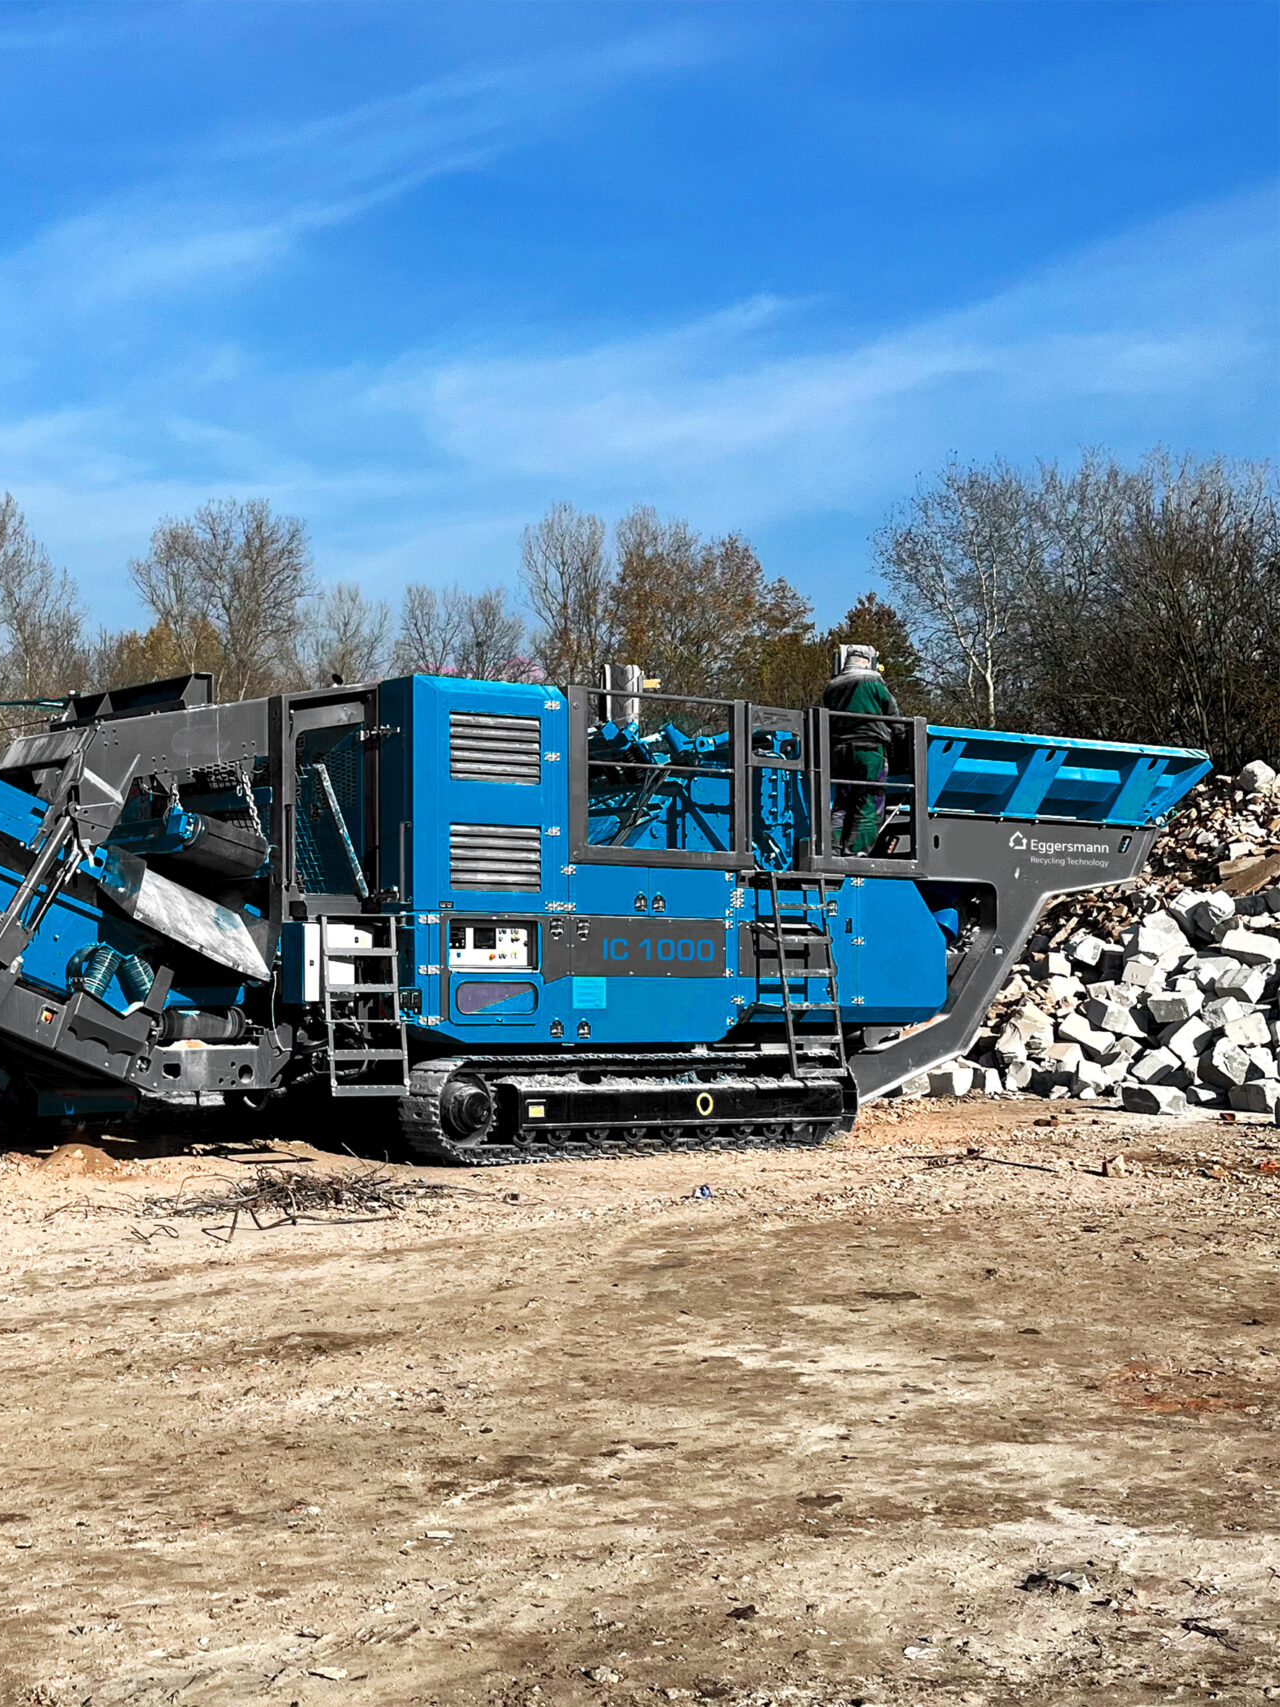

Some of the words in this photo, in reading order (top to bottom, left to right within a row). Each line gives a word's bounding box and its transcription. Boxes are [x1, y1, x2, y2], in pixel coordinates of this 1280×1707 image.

[1030, 839, 1110, 854] Eggersmann
[1030, 856, 1066, 867] Recycling
[1067, 857, 1109, 868] Technology
[602, 938, 629, 961] IC
[638, 938, 715, 962] 1000
